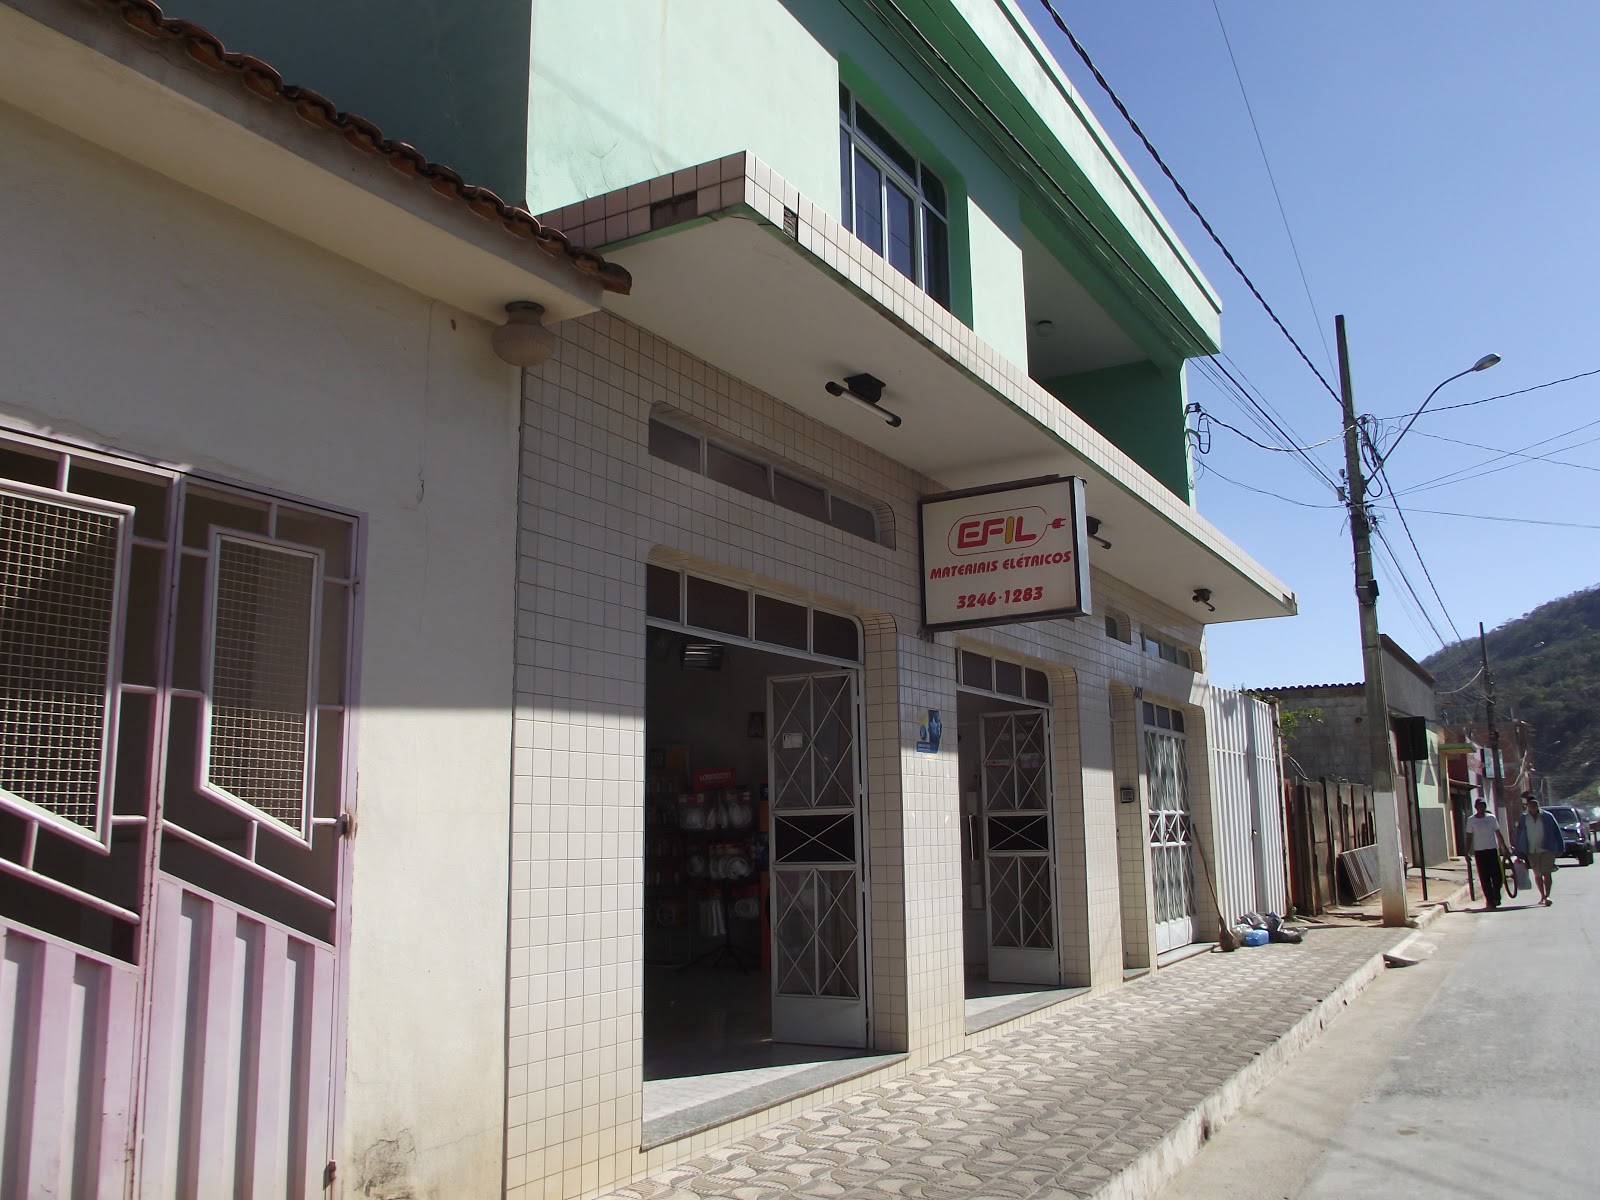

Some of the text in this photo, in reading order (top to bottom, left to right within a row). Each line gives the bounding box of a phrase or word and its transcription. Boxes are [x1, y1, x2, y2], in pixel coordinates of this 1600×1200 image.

[957, 515, 1037, 549] EFIL
[930, 551, 1072, 579] MATERIAIS ELÉTRICOS
